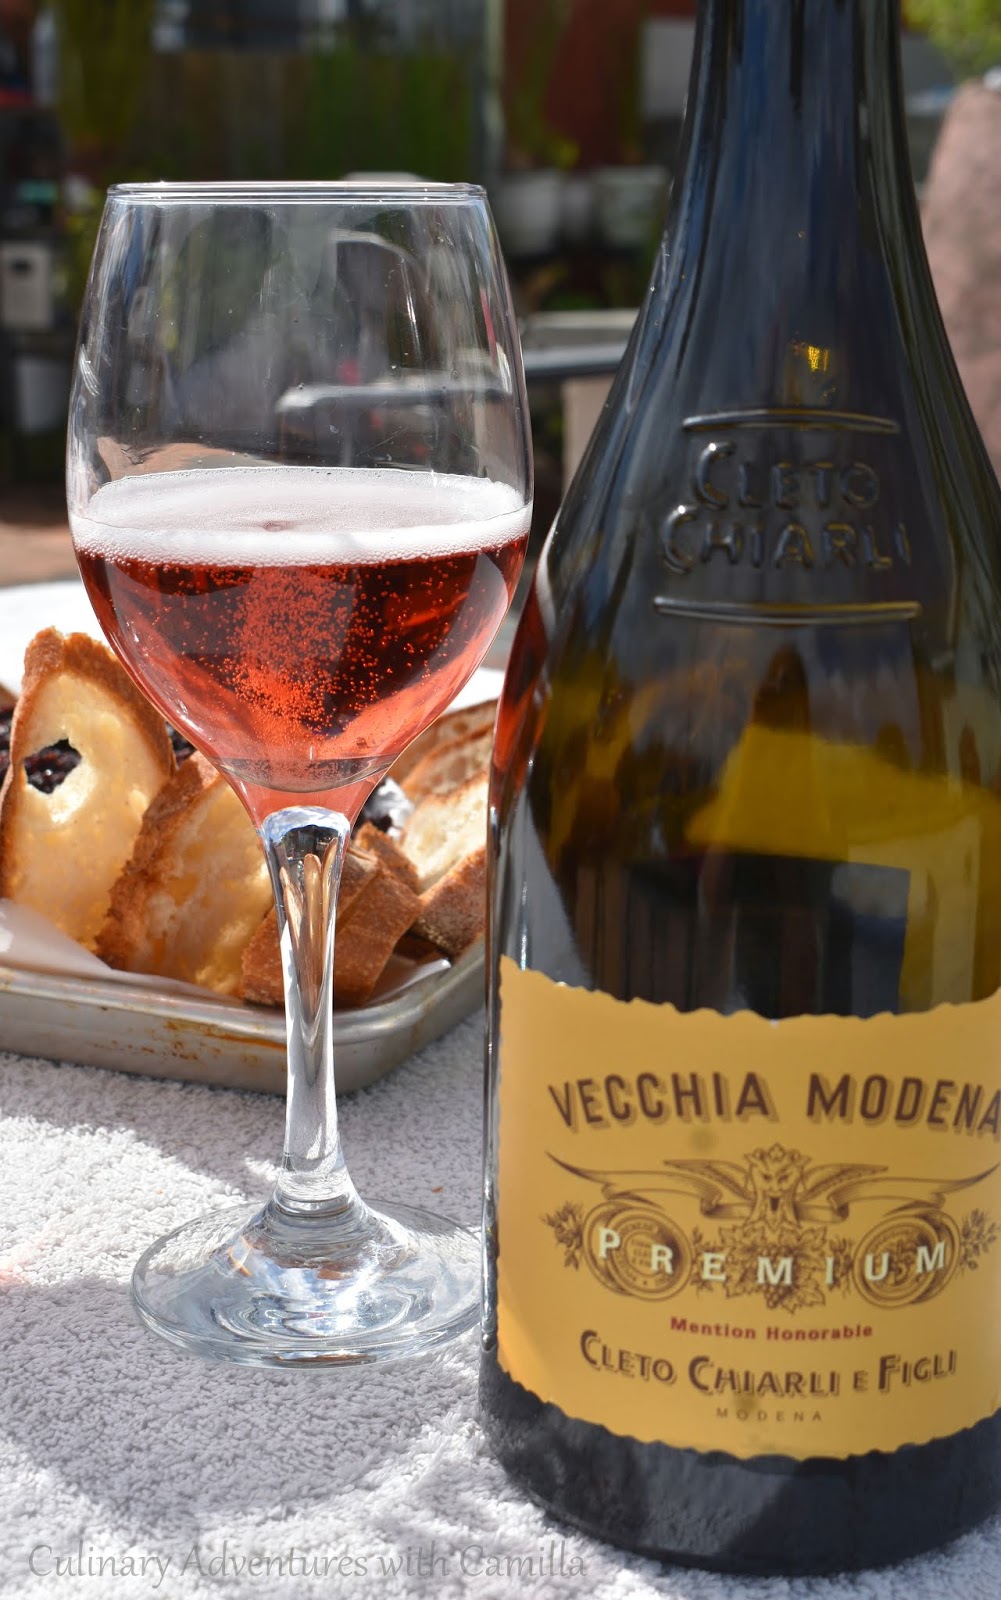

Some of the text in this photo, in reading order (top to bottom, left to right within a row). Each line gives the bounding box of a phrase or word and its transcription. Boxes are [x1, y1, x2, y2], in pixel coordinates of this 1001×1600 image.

[695, 440, 880, 510] CLETO
[662, 504, 911, 574] CHIARLI
[549, 1071, 1001, 1139] VECCHIA MODENA
[598, 1226, 946, 1285] PREMIUM
[670, 1316, 873, 1342] Mention Honorable
[580, 1330, 675, 1383] CLETO
[688, 1355, 841, 1397] CHIARLI
[877, 1348, 957, 1392] FIGLI
[716, 1406, 823, 1422] MODENA
